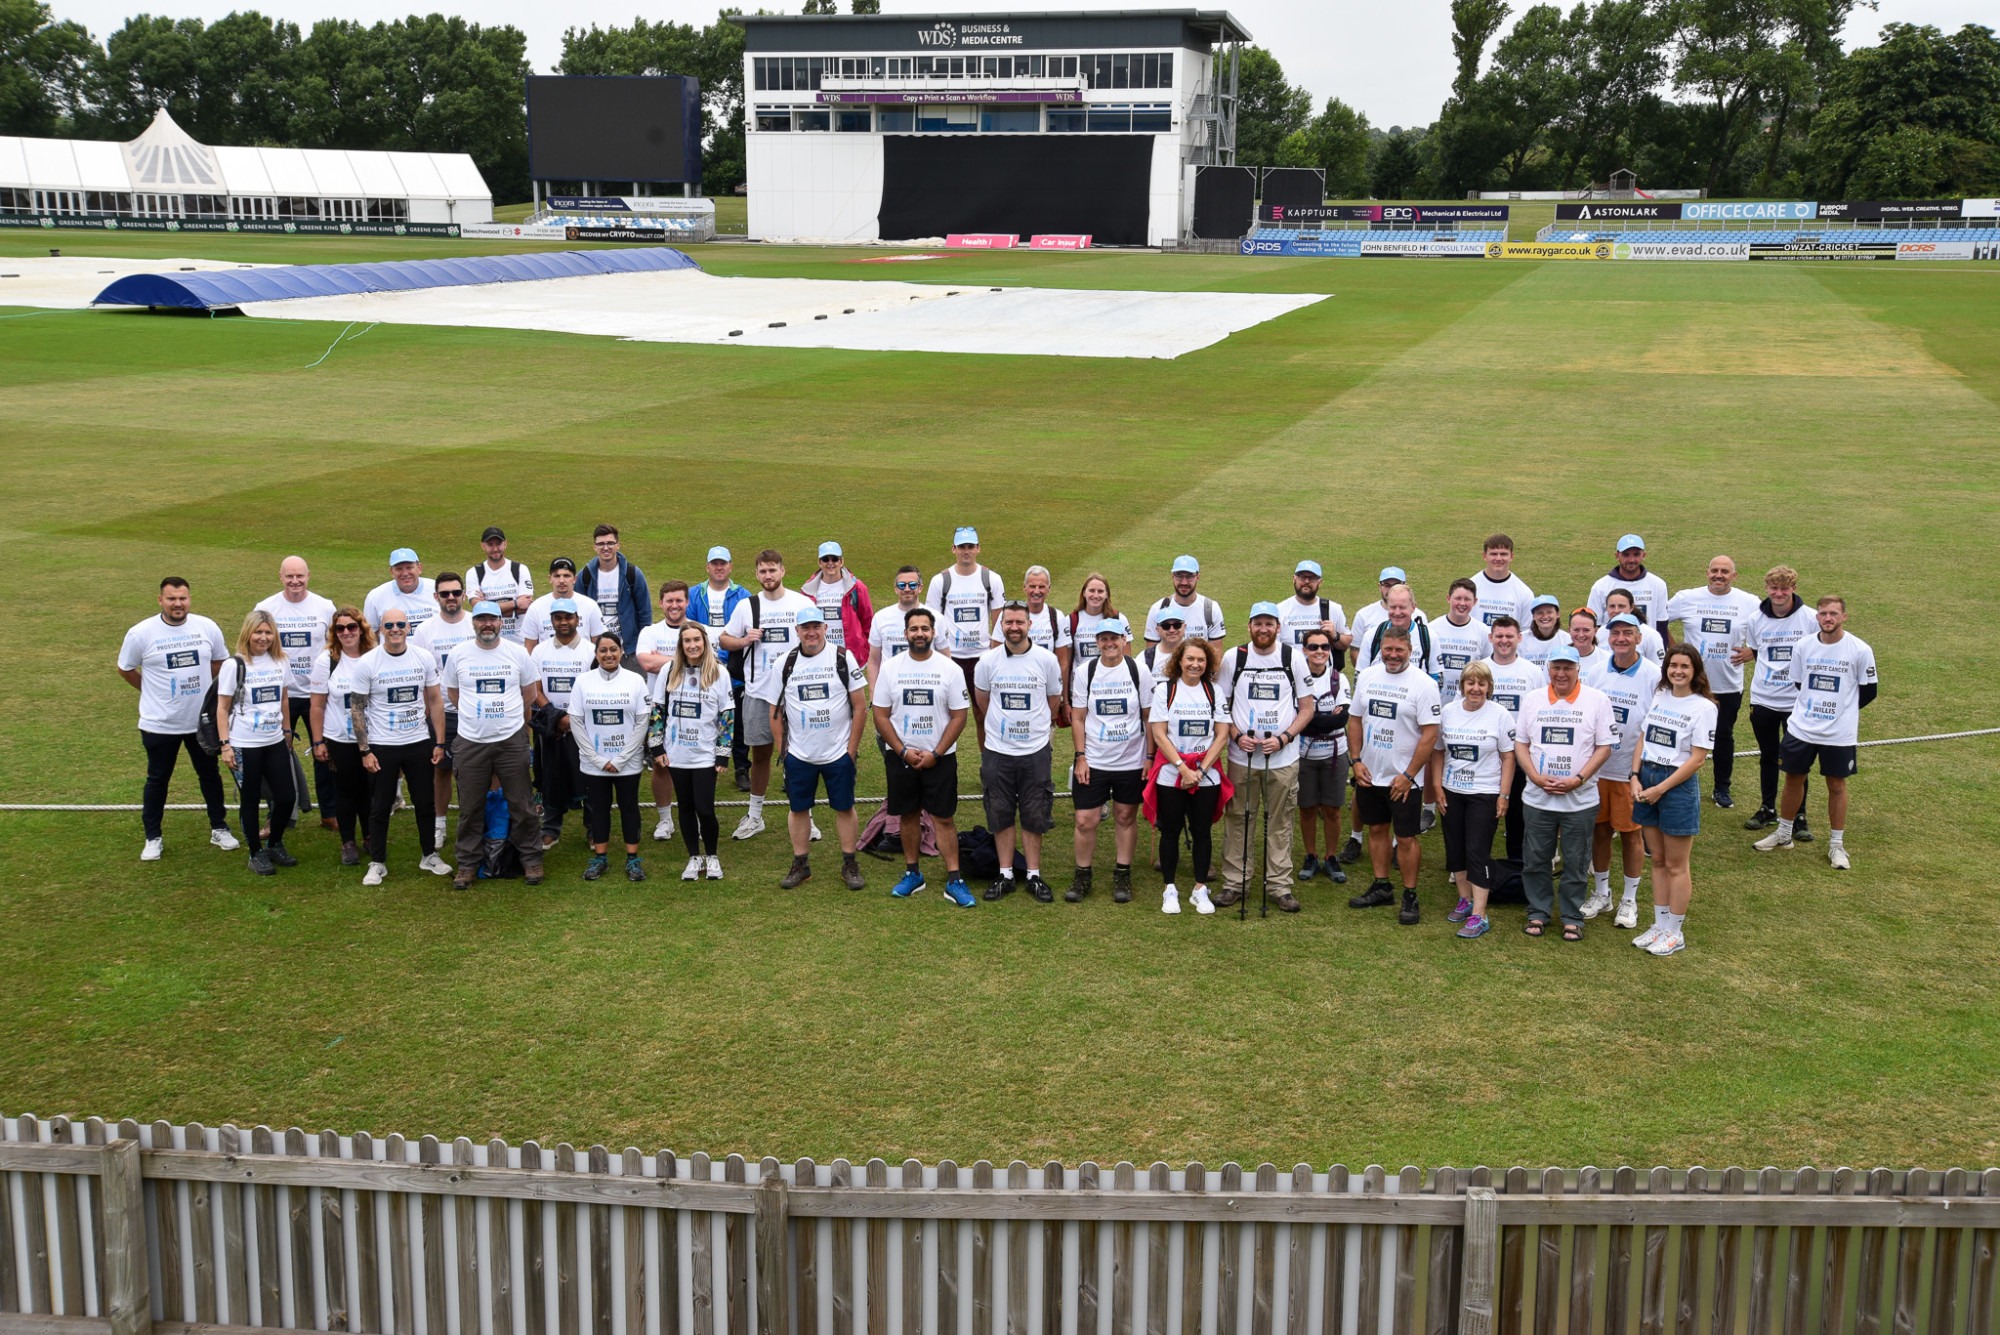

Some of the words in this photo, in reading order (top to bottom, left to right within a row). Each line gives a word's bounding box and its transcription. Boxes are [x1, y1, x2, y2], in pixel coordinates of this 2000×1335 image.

[962, 24, 1002, 33] BUSINESS
[1003, 24, 1010, 33] &
[918, 30, 952, 46] WDS
[962, 36, 988, 45] MEDIA
[990, 36, 1022, 44] CENTRE
[902, 94, 918, 102] Copy
[1384, 208, 1412, 217] arc
[1594, 208, 1658, 217] ASTONLARK
[1686, 204, 1786, 218] OFFICECARE
[40, 218, 55, 226] IPA
[104, 218, 118, 228] IPA
[166, 220, 180, 230] IPA
[226, 222, 240, 231] IPA
[284, 223, 296, 232] IPA
[340, 224, 352, 232] IPA
[394, 225, 406, 233] IPA
[447, 225, 460, 234] IPA
[1256, 243, 1281, 251] RDS
[1508, 247, 1591, 256] www.raygar.co.uk
[1633, 244, 1747, 255] www.evad.co.uk
[1374, 741, 1392, 749] FUND
